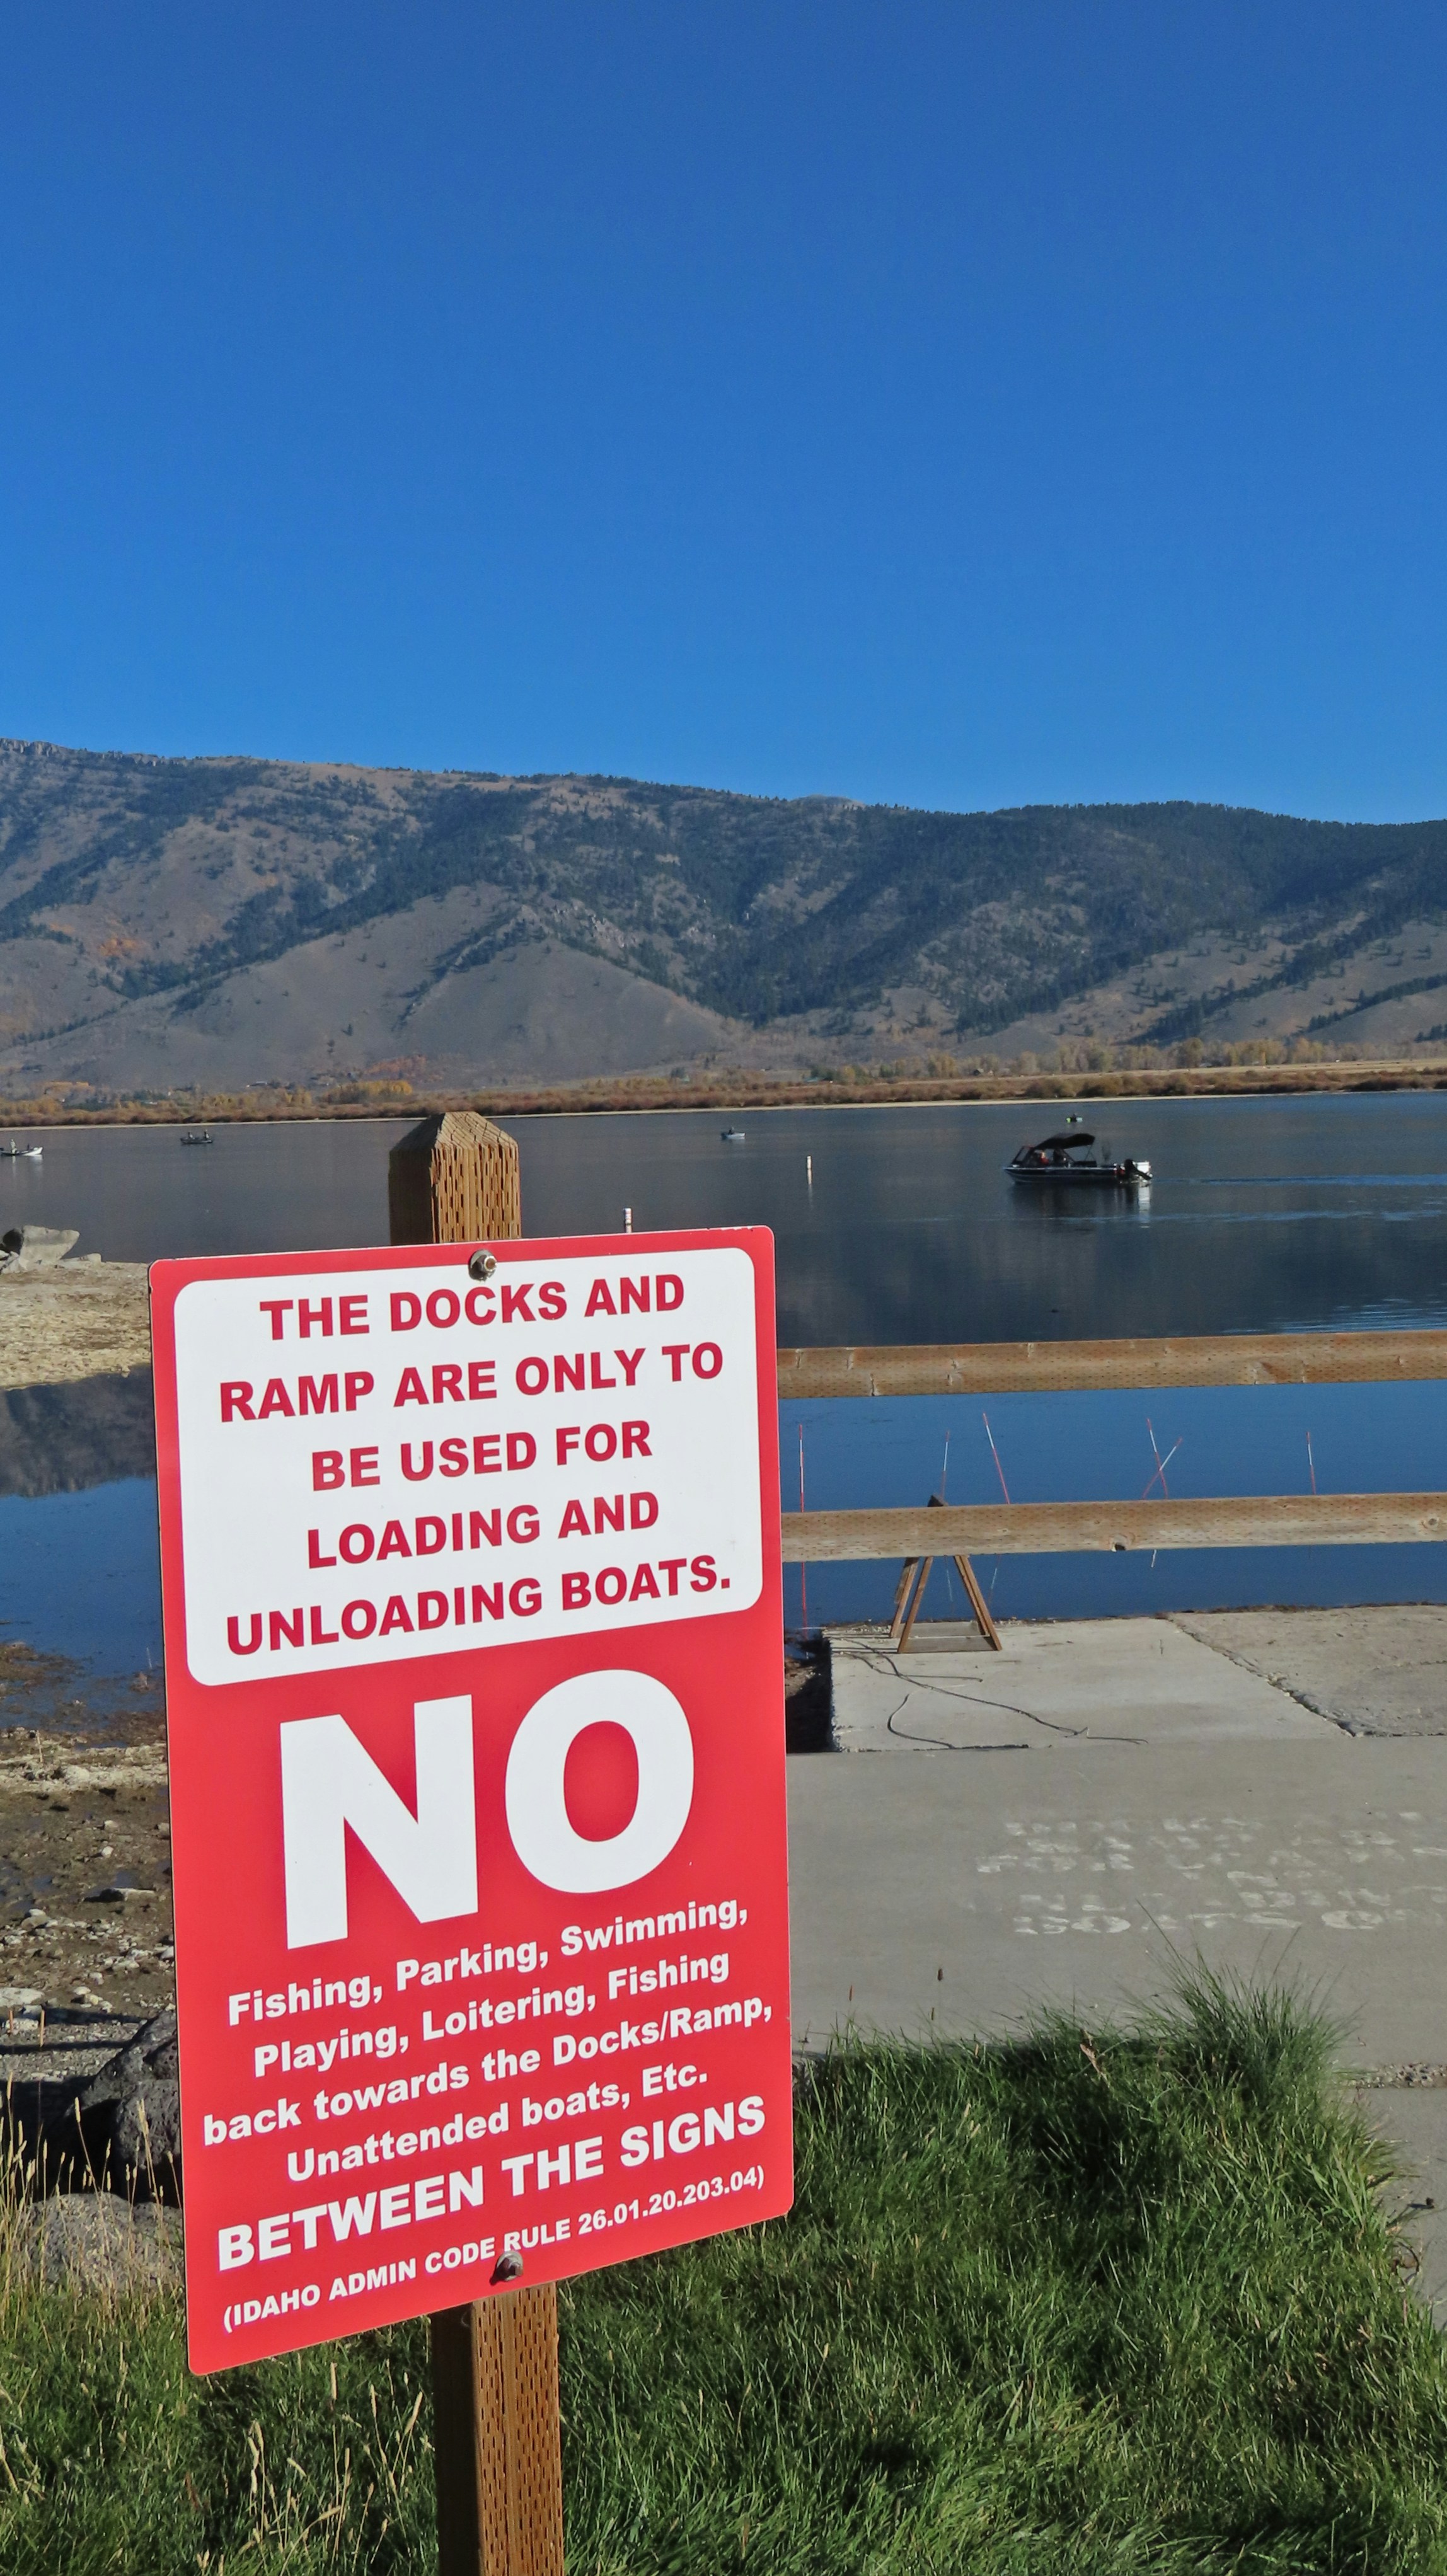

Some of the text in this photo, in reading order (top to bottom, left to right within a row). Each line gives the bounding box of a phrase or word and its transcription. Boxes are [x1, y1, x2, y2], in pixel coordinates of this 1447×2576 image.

[259, 1274, 684, 1340] THE DOCKS AND
[220, 1342, 724, 1422] RAMP ARE ONLY TO
[312, 1420, 652, 1491] BE USED FOR
[308, 1492, 659, 1569] LOADING AND
[227, 1555, 730, 1655] UNLOADING BOATS.
[280, 1669, 694, 1950] NO
[229, 1899, 747, 2027] Fishing, Parking, Swimming,
[255, 1951, 729, 2078] Playing, Loitering, Fishing
[204, 1997, 771, 2146] back towards the Docks/Ramp,
[287, 2062, 707, 2182] Unattended boats, Etc.
[218, 2095, 765, 2271] BETWEEN THE SIGNS
[224, 2165, 764, 2333] (IDAHO ADMIN CODE RULE 26.01.20.203.04)
